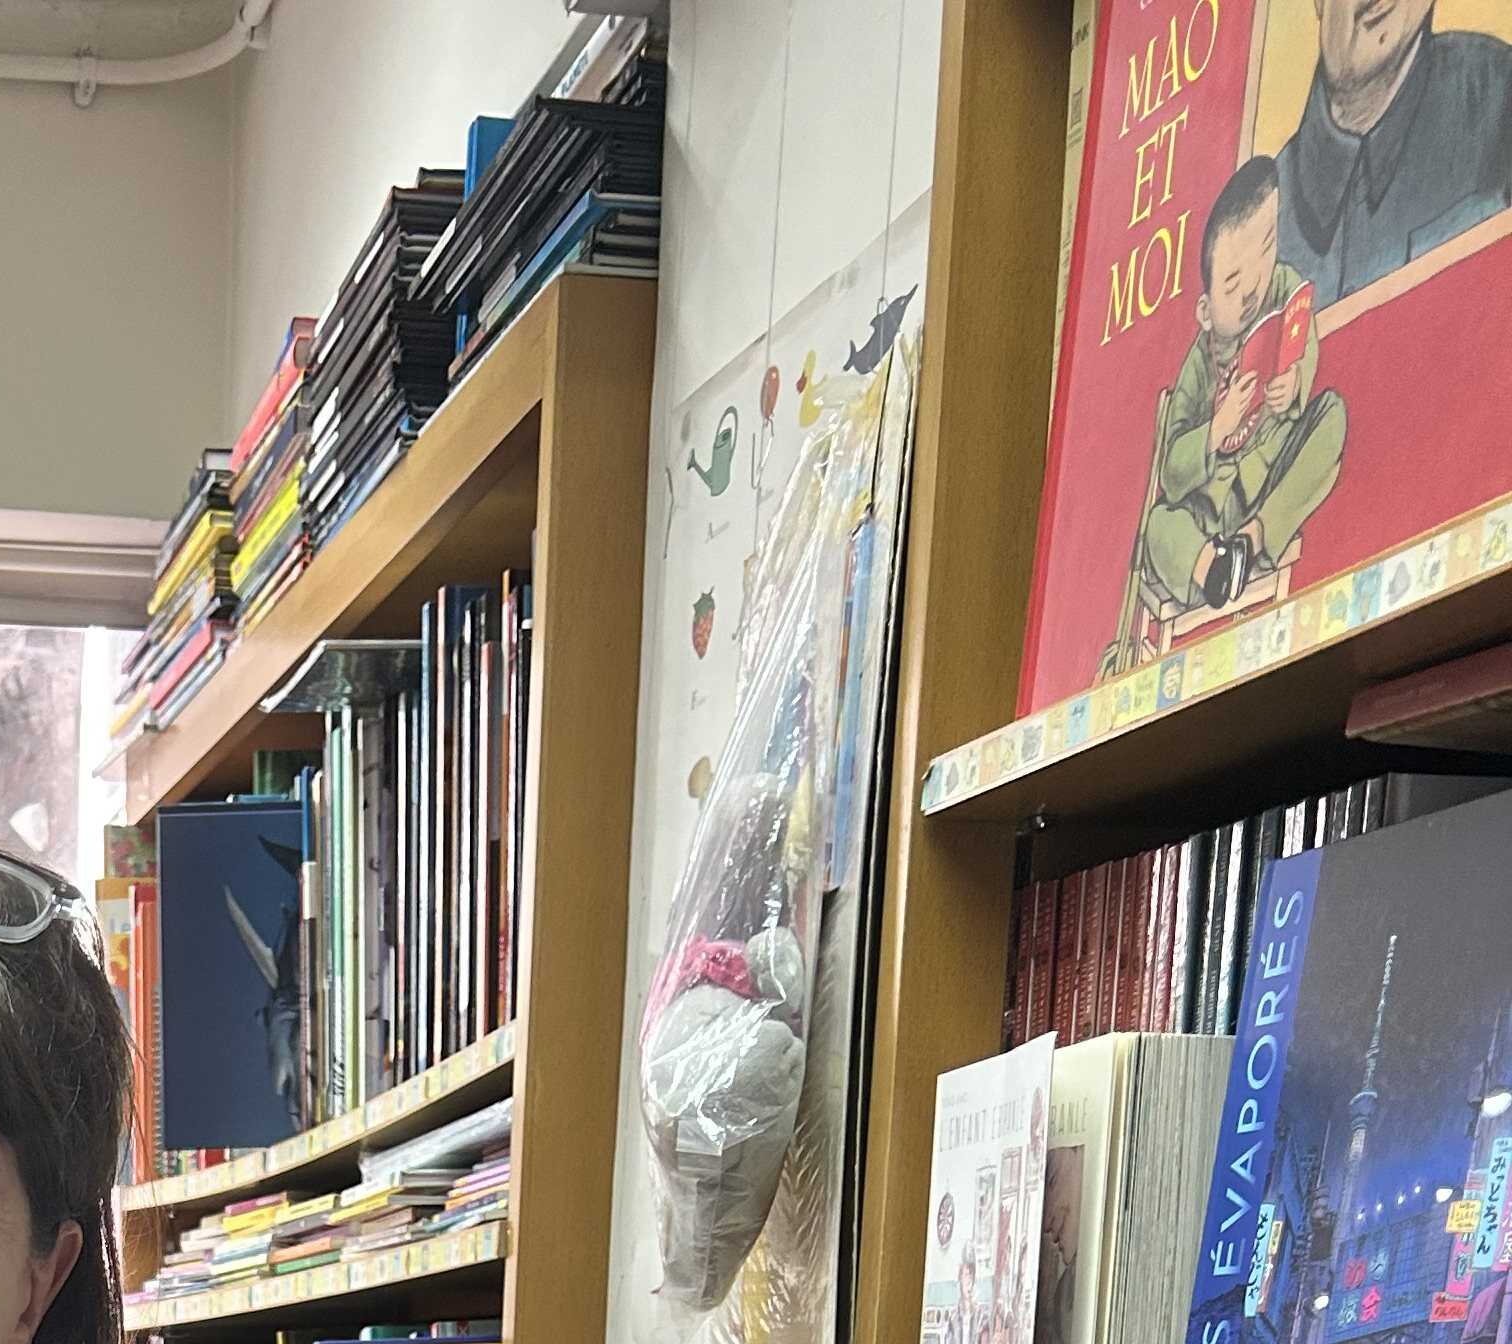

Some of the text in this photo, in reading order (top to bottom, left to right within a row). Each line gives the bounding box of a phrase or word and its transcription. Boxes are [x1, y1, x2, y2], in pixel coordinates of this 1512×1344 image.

[1119, 0, 1219, 140] MAO
[1128, 104, 1189, 230] ET
[1099, 209, 1191, 347] MOI
[1210, 896, 1307, 1278] ÉVAPORÉS
